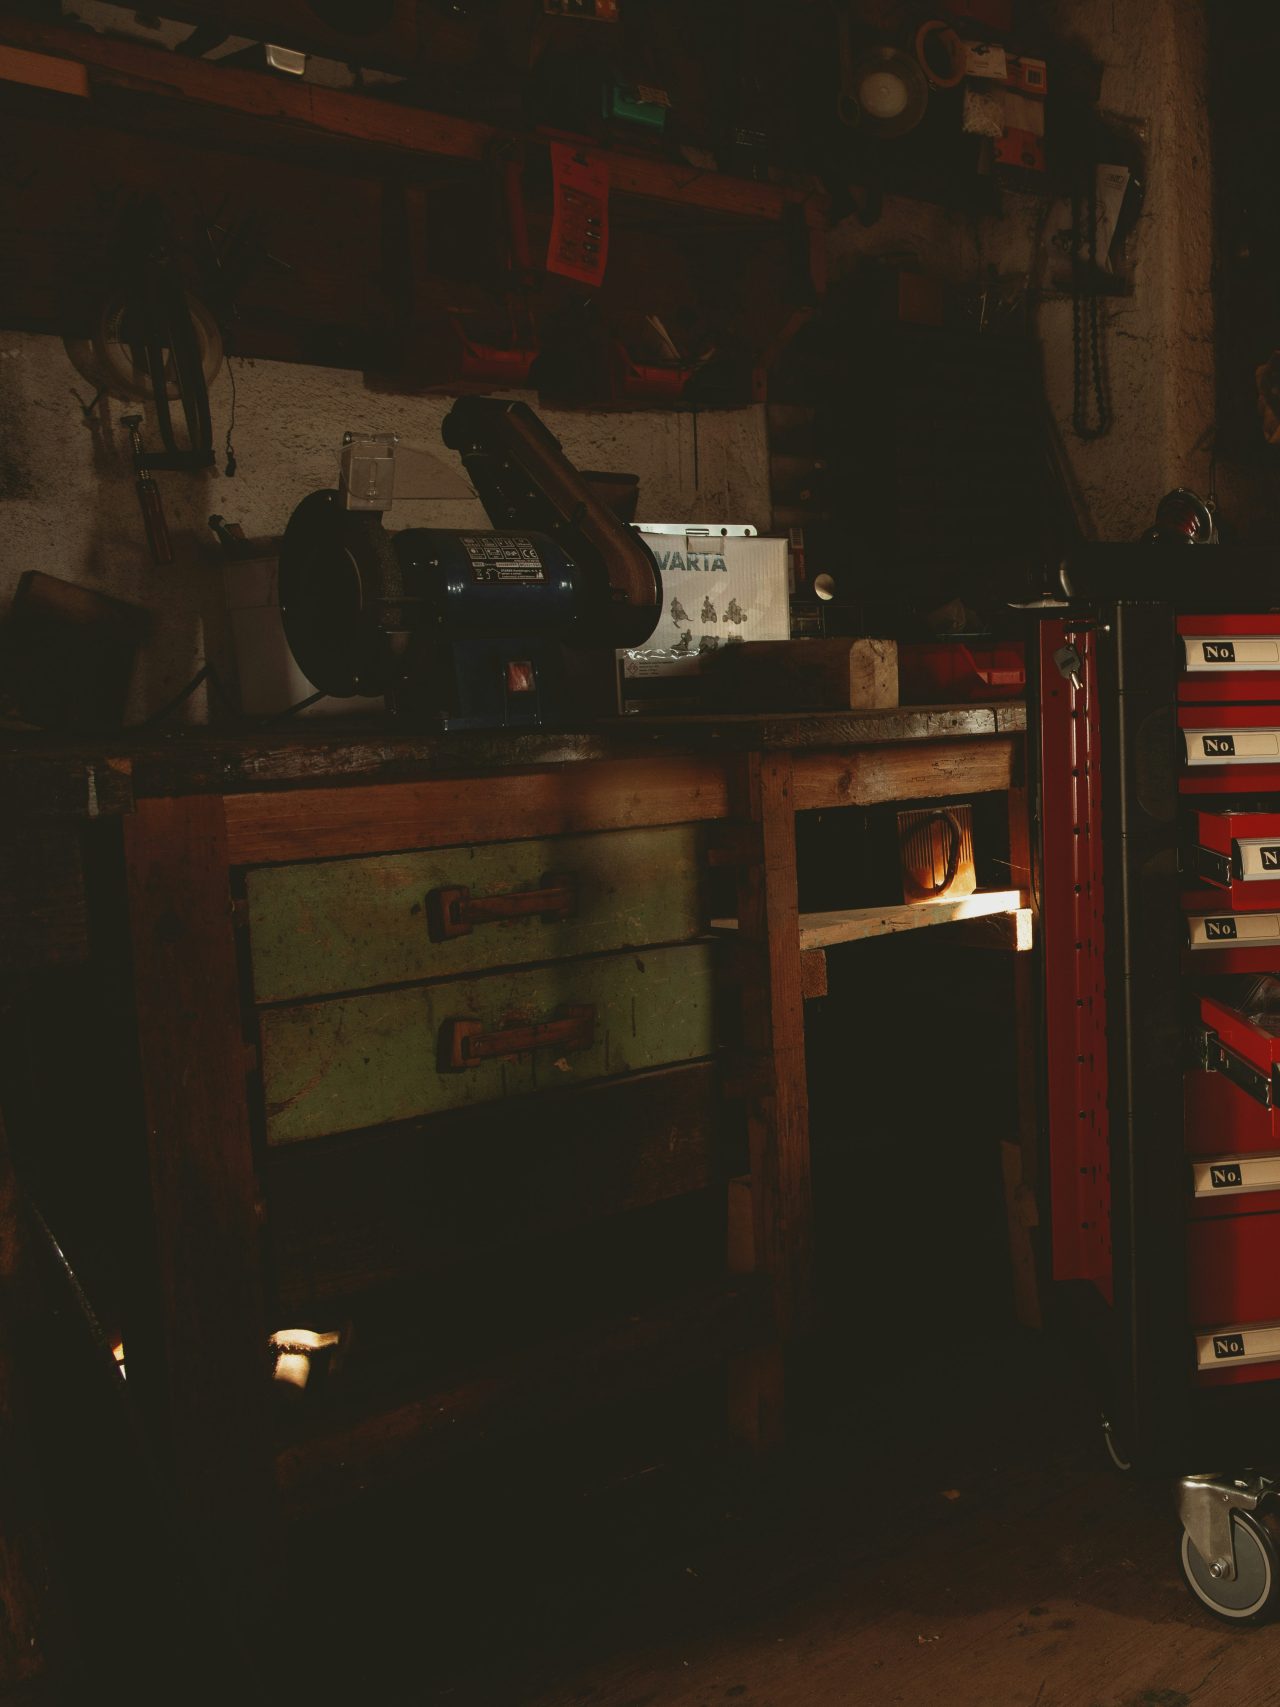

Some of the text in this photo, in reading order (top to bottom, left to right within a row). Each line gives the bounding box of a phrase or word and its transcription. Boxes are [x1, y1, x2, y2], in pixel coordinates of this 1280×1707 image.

[653, 551, 728, 572] VARTA
[1206, 646, 1234, 658] No.
[1206, 739, 1234, 752] No.
[1208, 922, 1236, 936] No.
[1213, 1170, 1241, 1183] No.
[1216, 1340, 1243, 1353] No.
